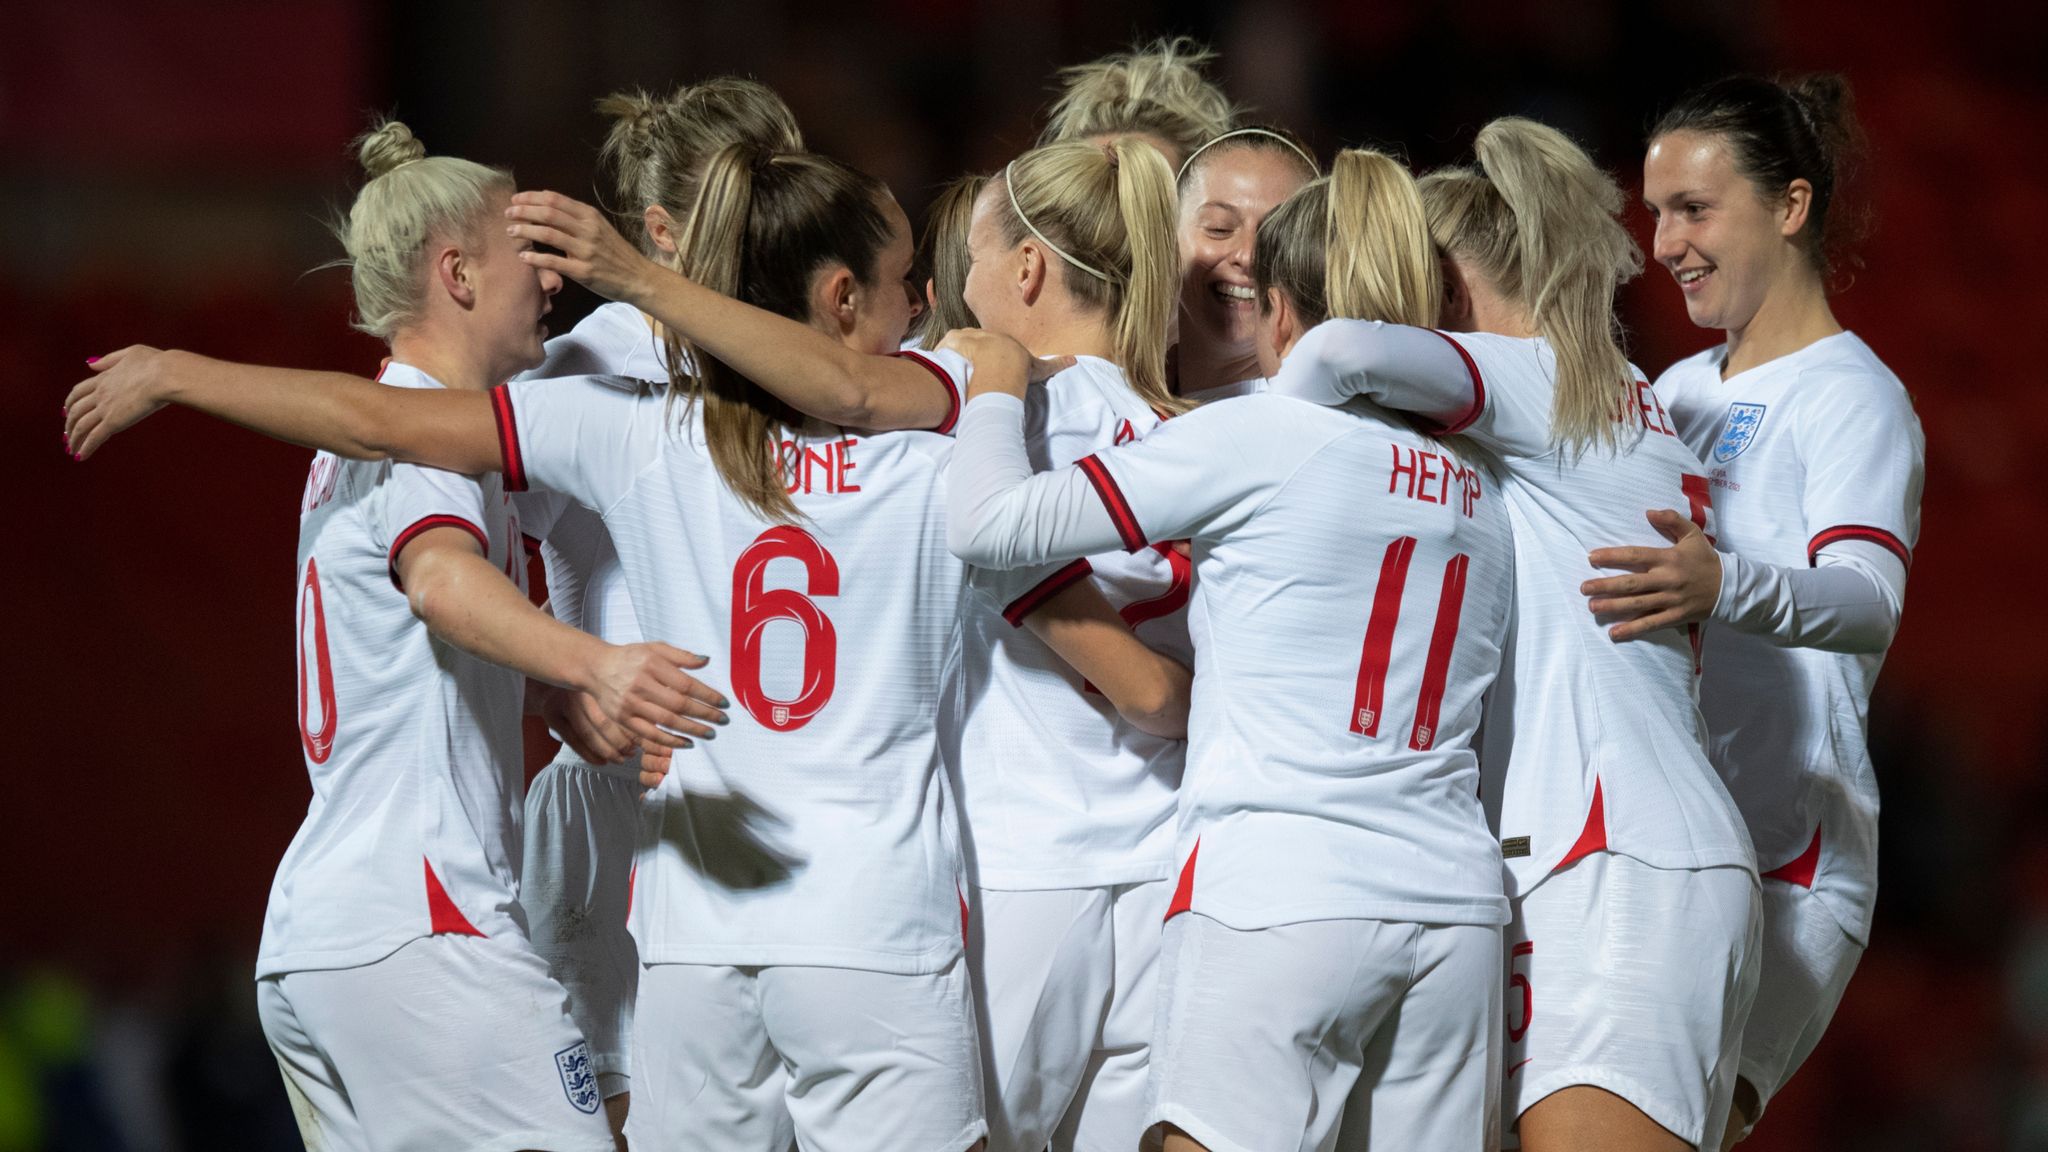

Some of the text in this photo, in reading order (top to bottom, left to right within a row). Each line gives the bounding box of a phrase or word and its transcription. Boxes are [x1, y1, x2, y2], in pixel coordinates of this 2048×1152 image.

[769, 438, 861, 495] ONE
[1388, 443, 1482, 519] HEMP
[730, 524, 840, 733] 6
[1349, 535, 1471, 752] 11
[1507, 940, 1534, 1043] 5
